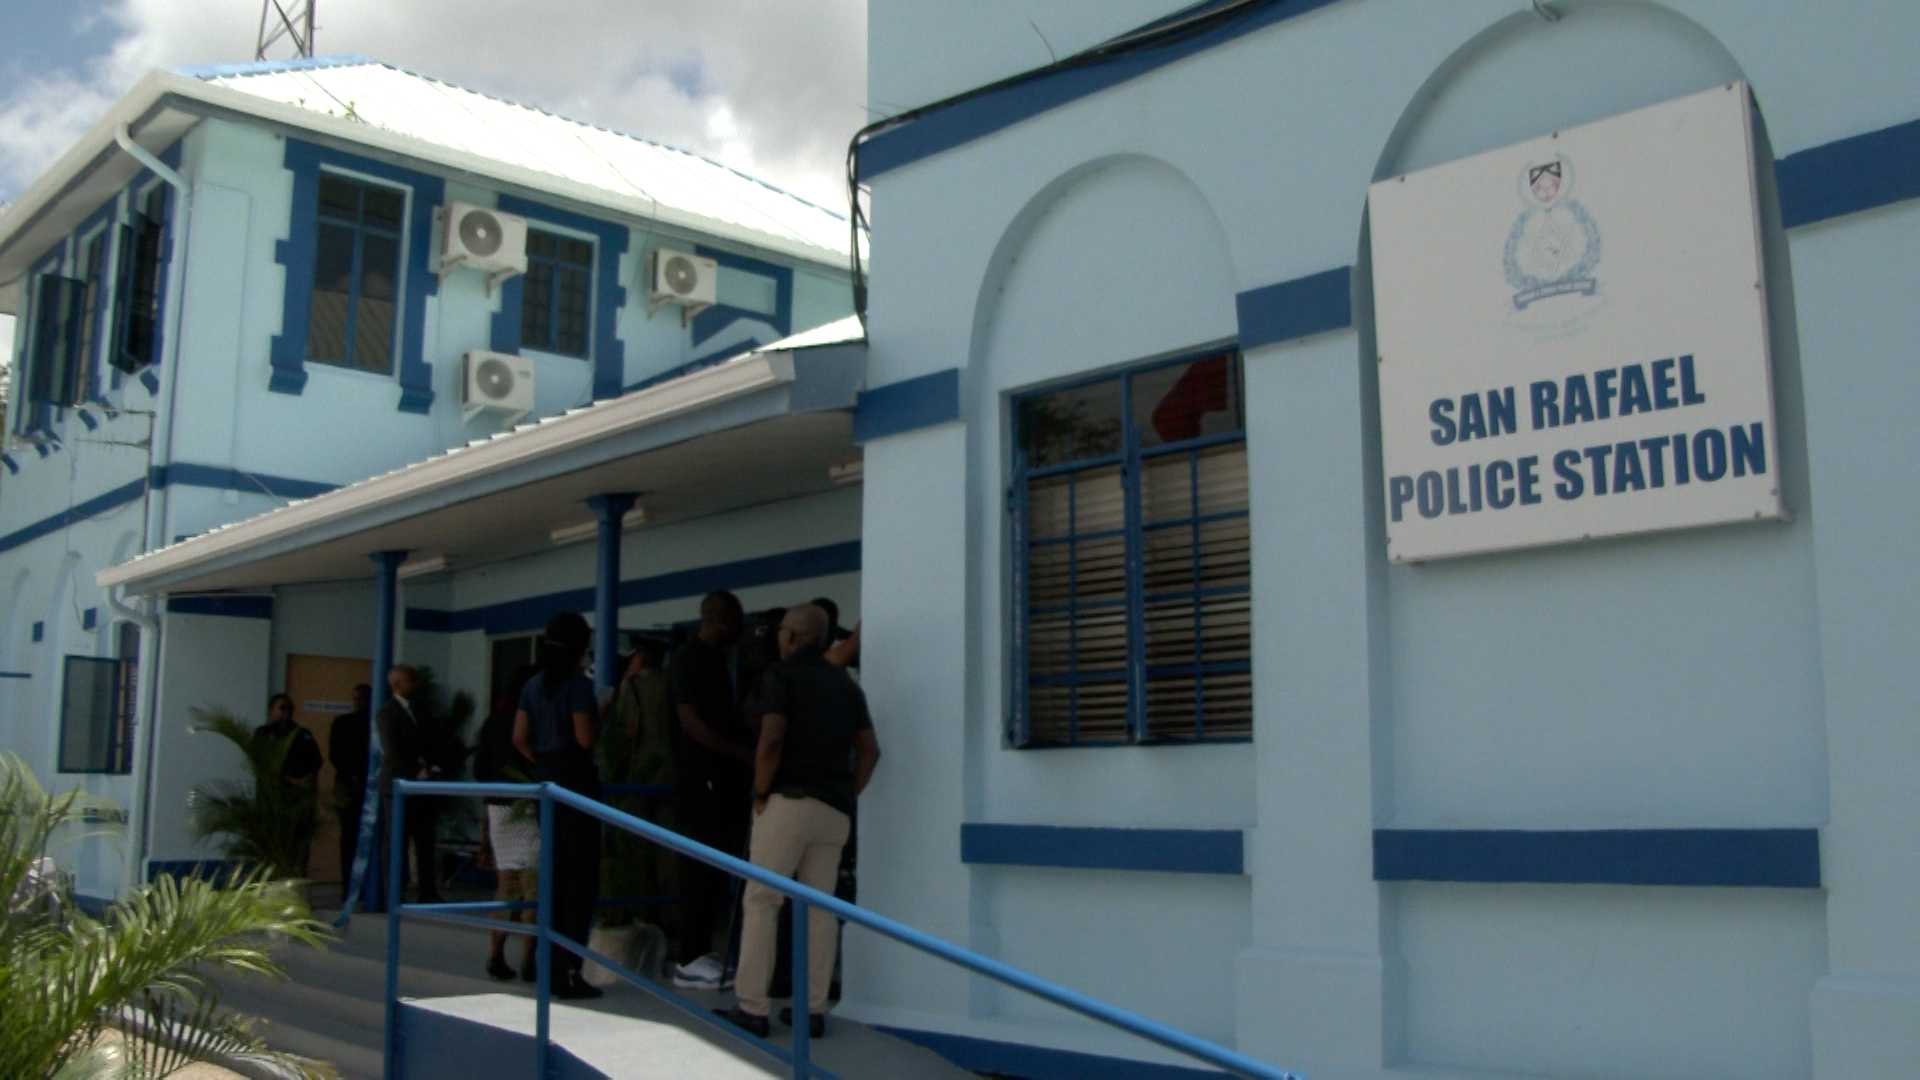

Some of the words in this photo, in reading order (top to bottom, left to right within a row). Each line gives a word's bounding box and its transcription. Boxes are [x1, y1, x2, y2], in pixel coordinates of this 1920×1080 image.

[1429, 387, 1517, 446] SAN
[1530, 354, 1706, 430] RAFAEL
[1389, 455, 1542, 522] POLICE
[1553, 422, 1767, 500] STATION
